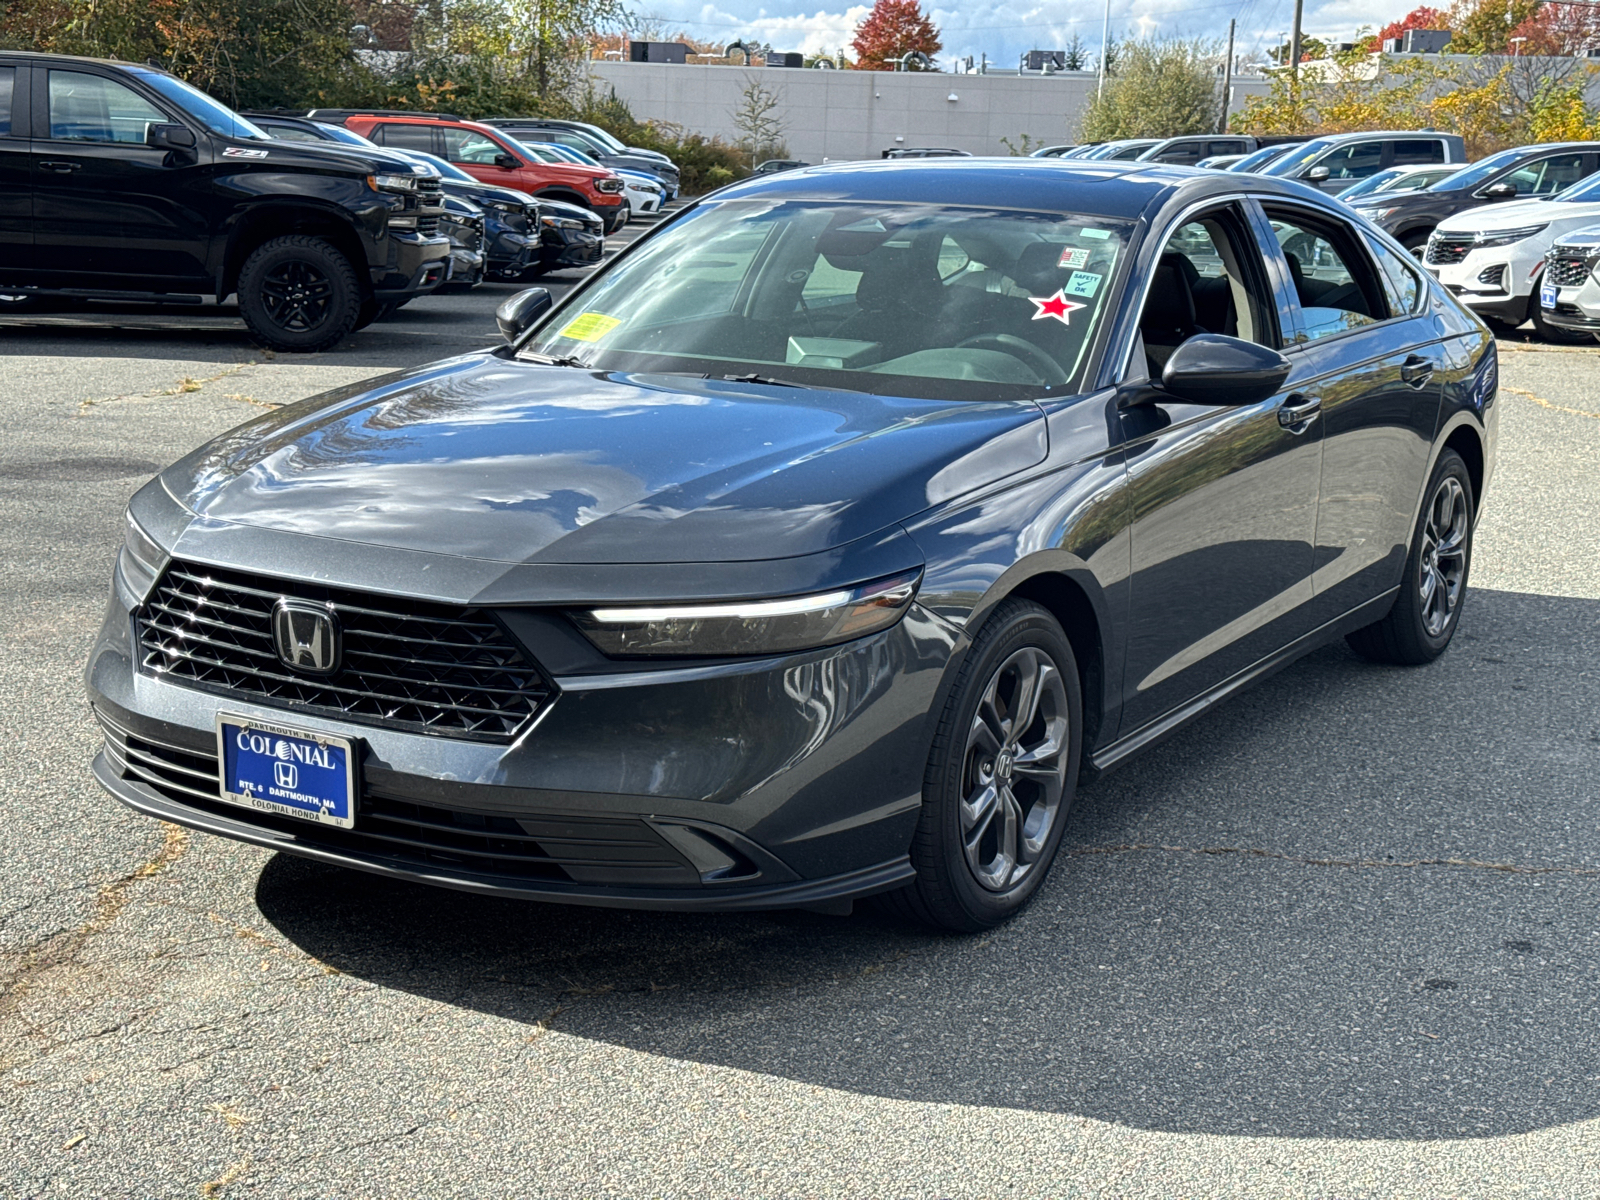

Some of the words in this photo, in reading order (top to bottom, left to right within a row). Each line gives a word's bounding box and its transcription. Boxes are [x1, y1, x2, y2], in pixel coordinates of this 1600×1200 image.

[1074, 273, 1099, 282] SAFETY
[303, 732, 317, 741] MA
[236, 731, 336, 770] COLONIAL
[238, 779, 257, 791] RTE.
[257, 784, 264, 793] 6
[269, 786, 322, 807] DARTMOUTH,
[322, 799, 336, 810] MA
[251, 799, 290, 814] COLONIAL
[291, 808, 320, 821] HONDA
